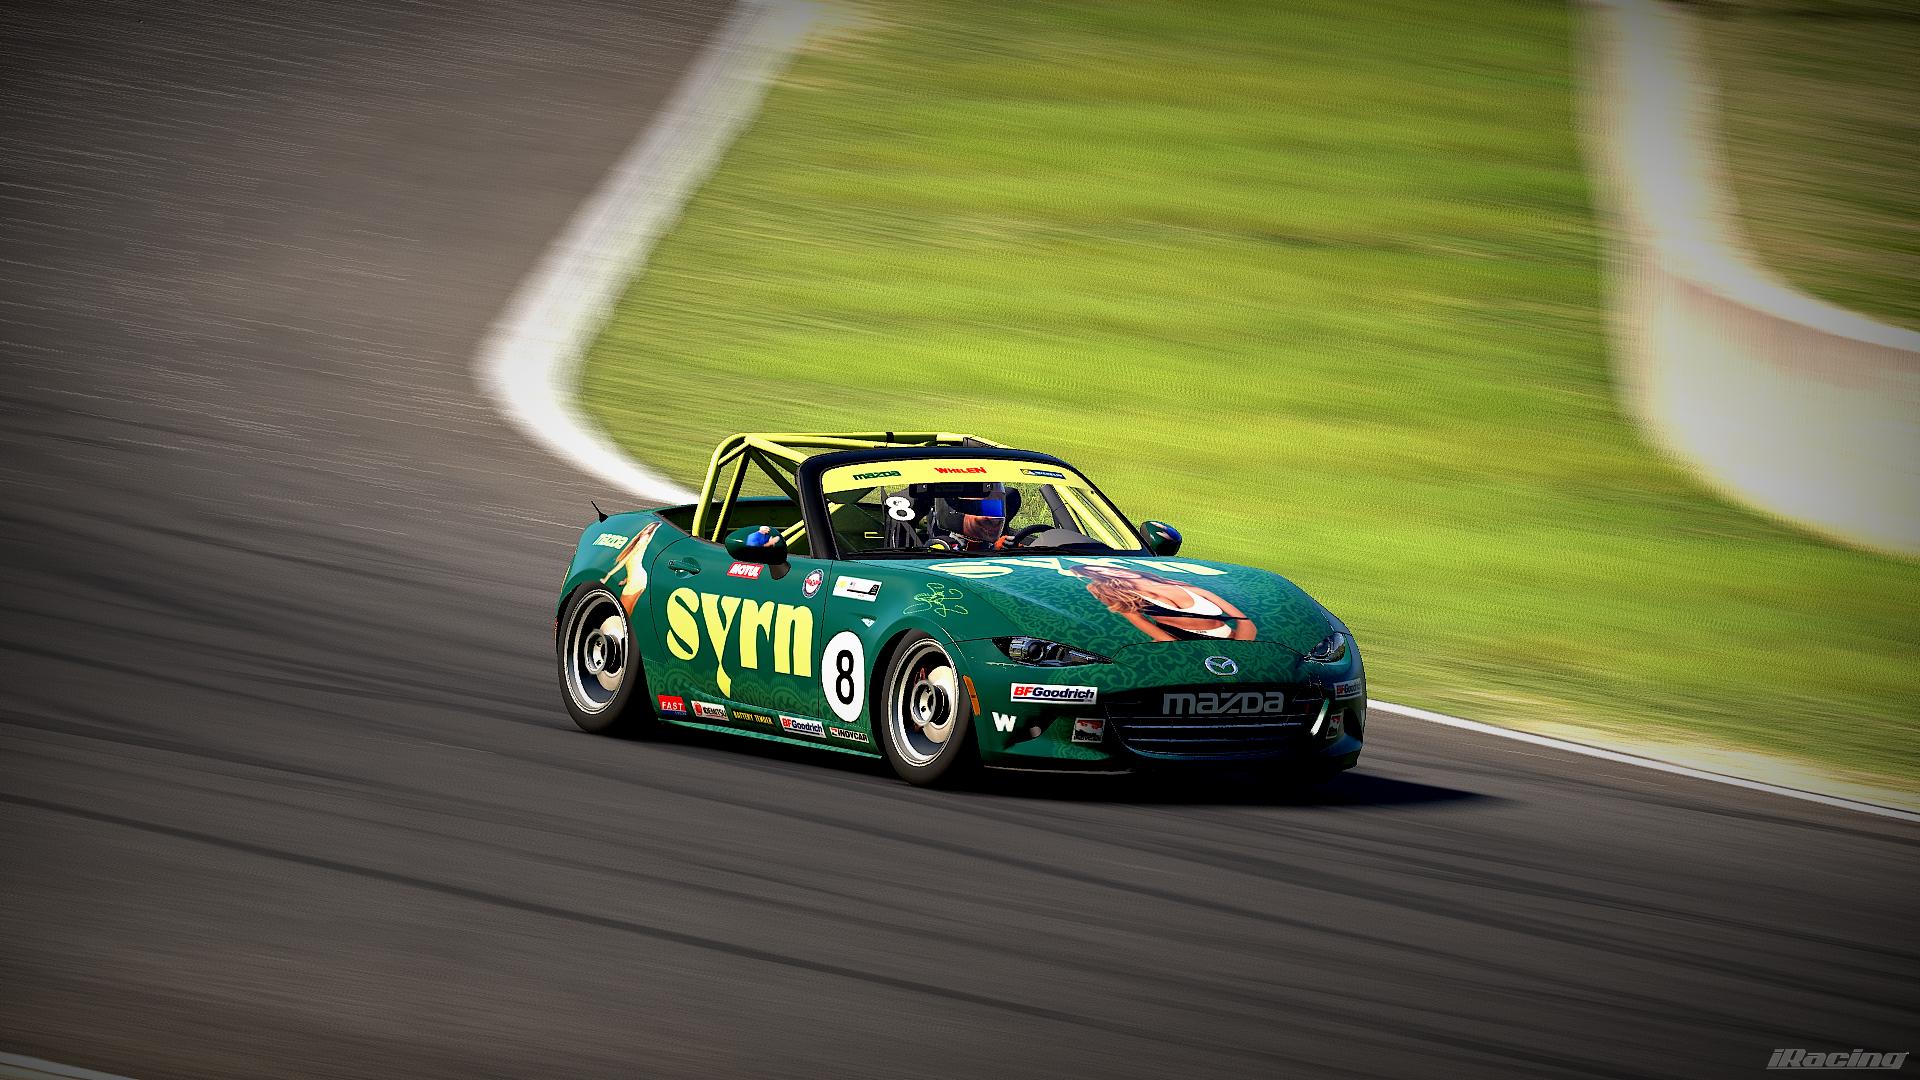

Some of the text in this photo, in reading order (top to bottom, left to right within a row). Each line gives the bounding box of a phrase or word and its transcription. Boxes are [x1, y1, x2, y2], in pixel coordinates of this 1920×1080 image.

[853, 471, 901, 480] mazda
[885, 496, 916, 521] 8
[592, 533, 629, 550] mazda
[729, 563, 761, 578] MOTUL
[667, 587, 814, 698] syrn
[836, 649, 855, 705] 8
[1013, 686, 1095, 699] BFGoodrich
[661, 701, 684, 711] FAST
[1162, 691, 1284, 715] mazda
[781, 717, 823, 733] BFGoodrich
[991, 711, 1018, 732] W
[837, 728, 868, 741] INDYCAR
